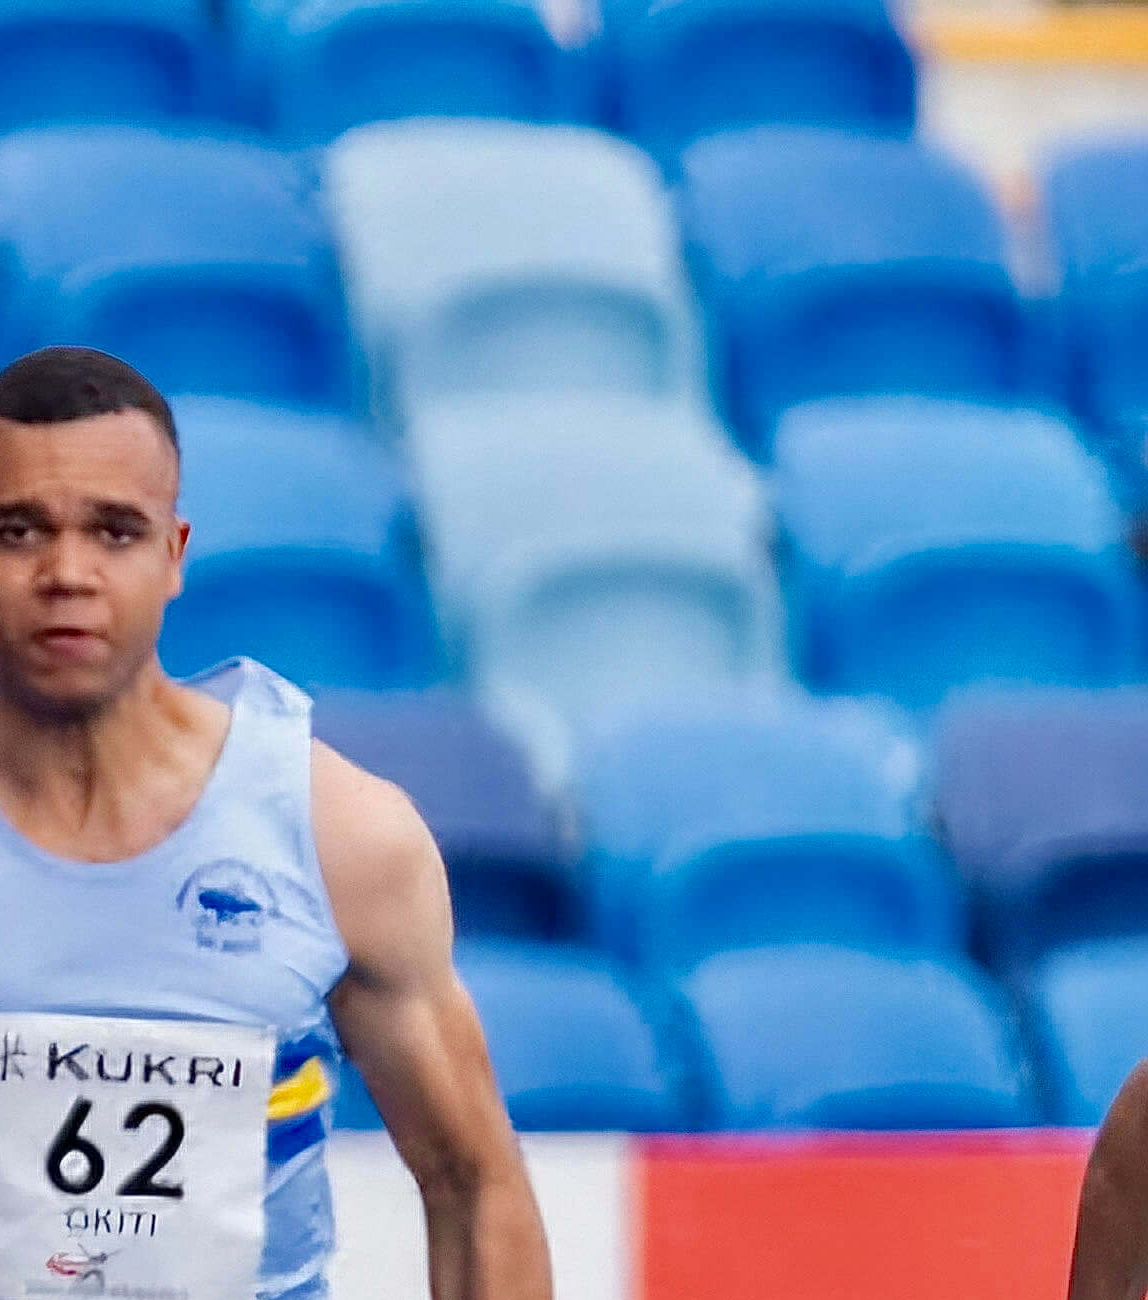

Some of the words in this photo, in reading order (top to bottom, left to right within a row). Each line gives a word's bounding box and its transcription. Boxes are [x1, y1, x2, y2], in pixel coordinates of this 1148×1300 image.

[47, 1042, 242, 1087] KUKRI
[46, 1096, 185, 1200] 62
[65, 1206, 157, 1237] OKITI
